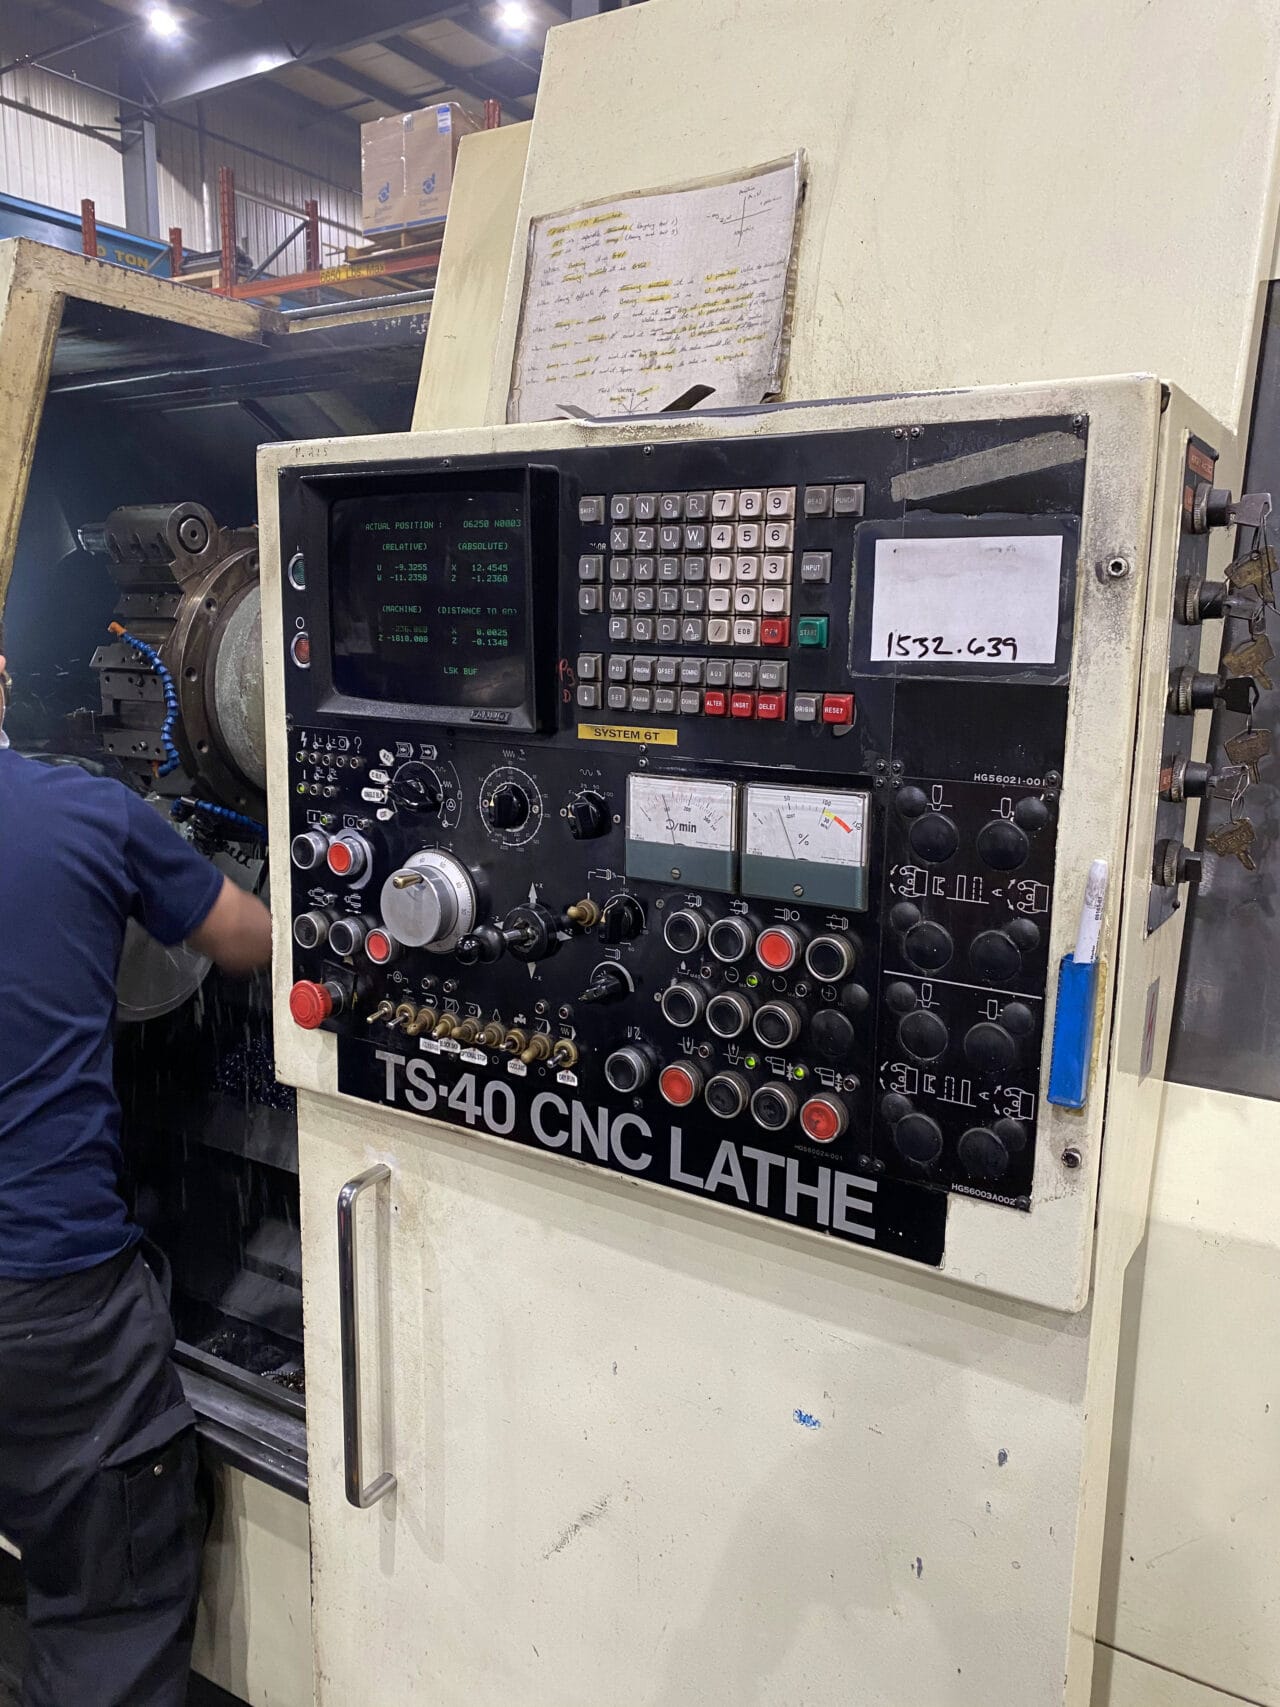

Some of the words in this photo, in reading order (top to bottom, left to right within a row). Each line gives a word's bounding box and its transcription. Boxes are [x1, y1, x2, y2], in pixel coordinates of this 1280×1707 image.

[640, 502, 649, 513] N
[664, 500, 672, 510] G
[690, 498, 698, 510] R
[720, 500, 726, 510] 7
[745, 498, 753, 510] 8
[772, 498, 781, 508] 9
[365, 522, 390, 531] ACTUAL
[394, 521, 434, 530] POSITION
[614, 532, 622, 542] X
[638, 531, 647, 542] Z
[664, 530, 672, 541] U
[688, 530, 699, 541] W
[717, 532, 725, 542] 4
[743, 531, 751, 541] 5
[771, 530, 780, 540] 6
[382, 543, 428, 551] (RELATIVE)
[458, 542, 508, 551] (ABSOLUTE)
[639, 564, 647, 574] K
[664, 564, 672, 574] E
[690, 564, 698, 574] F
[742, 563, 751, 574] 2
[769, 563, 778, 574] 3
[612, 592, 622, 602] M
[638, 591, 645, 602] S
[663, 592, 670, 603] T
[687, 592, 694, 603] L
[382, 605, 422, 614] (MACHINE)
[437, 606, 481, 615] (DISTANCE
[612, 621, 619, 632] P
[636, 622, 645, 633] Q
[662, 625, 670, 635] D
[686, 623, 694, 633] A
[886, 632, 1018, 661] 1532.639
[463, 667, 478, 676] BUF
[594, 728, 640, 740] SYSTEM
[644, 732, 661, 741] 6T
[974, 773, 1046, 786] HG56021-001
[374, 1050, 517, 1135] TS-40
[530, 1092, 653, 1172] CNC
[670, 1126, 878, 1240] LATHE
[951, 1183, 1016, 1206] HG56003A002
